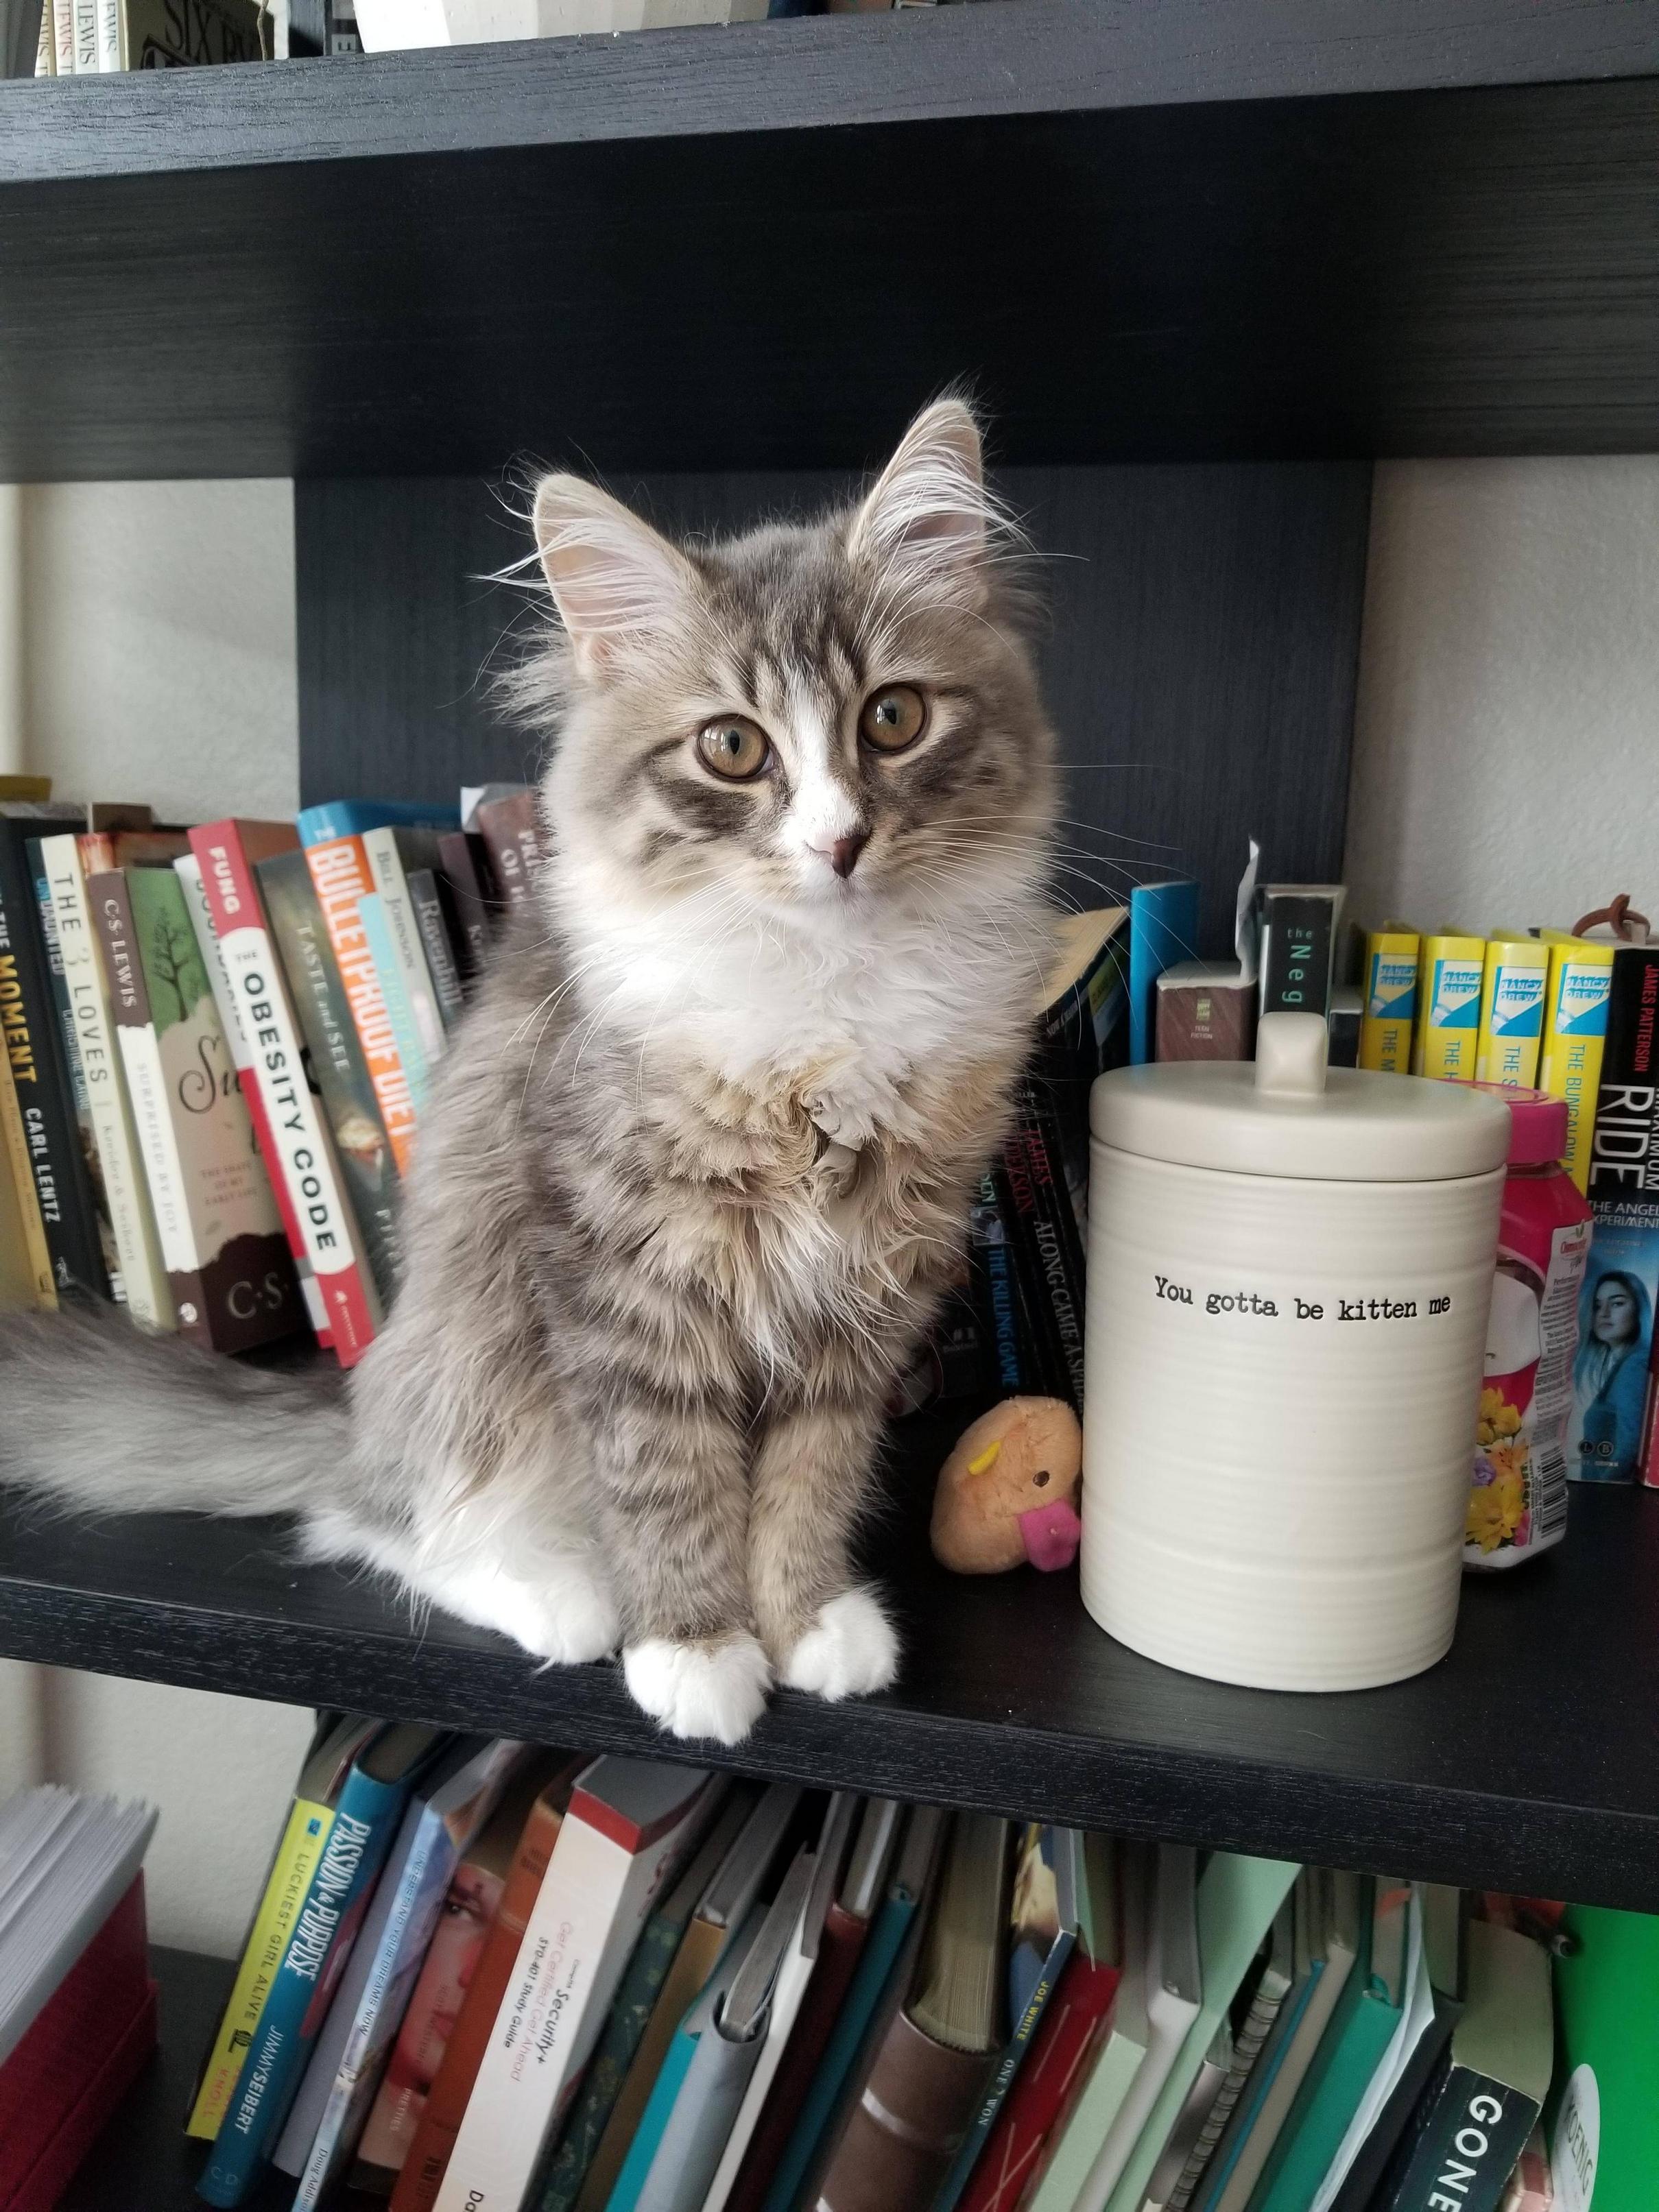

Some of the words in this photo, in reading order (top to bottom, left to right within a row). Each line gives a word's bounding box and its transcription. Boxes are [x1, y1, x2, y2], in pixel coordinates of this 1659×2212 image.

[77, 4, 96, 64] LEWIS
[103, 1, 117, 53] EWIS
[208, 845, 241, 915] FUNG
[235, 948, 260, 963] THE
[1287, 927, 1313, 939] the
[54, 874, 82, 931] THE
[74, 985, 108, 1083] LOVES
[111, 939, 138, 1008] LEWIS
[1643, 963, 1659, 1005] JAMES
[0, 954, 38, 1083] MOMENT
[1634, 1007, 1655, 1073] PATTERSON
[1381, 1030, 1398, 1054] THE
[1444, 1039, 1461, 1066] THE
[1503, 1046, 1521, 1073] THE
[1568, 1044, 1586, 1071] THE
[25, 1107, 50, 1159] CARL
[243, 973, 306, 1134] OBESITY
[294, 1149, 337, 1251] CODE
[1590, 1083, 1656, 1190] RIDE
[36, 1164, 61, 1223] LENTZ
[1593, 1214, 1659, 1229] XPERIMENT
[988, 1248, 1006, 1277] THE
[1032, 1219, 1066, 1286] ALONG
[1049, 1286, 1080, 1342] CAME
[991, 1277, 1016, 1339] KILLING
[1155, 1275, 1193, 1305] You
[1206, 1291, 1278, 1317] gotta
[1294, 1298, 1324, 1320] be
[1337, 1298, 1417, 1321] kitten
[1429, 1295, 1451, 1314] me
[998, 1338, 1020, 1388] GAME
[315, 1812, 372, 1897] PASSION
[276, 1852, 310, 1929] LUCKIEST
[260, 1934, 282, 1969] GIRL
[385, 1930, 402, 1958] YOUR
[243, 1973, 269, 2021] ALIVE
[368, 1958, 392, 2007] DREAMS
[514, 1982, 534, 2015] Study
[1034, 1980, 1051, 2003] JOE
[360, 2008, 374, 2036] NOW
[504, 2015, 524, 2049] Guide
[1016, 2006, 1039, 2041] WHITE
[996, 2059, 1015, 2084] ONE
[978, 2098, 999, 2126] WON
[310, 2148, 329, 2176] Doug
[1427, 2095, 1503, 2212] GONE
